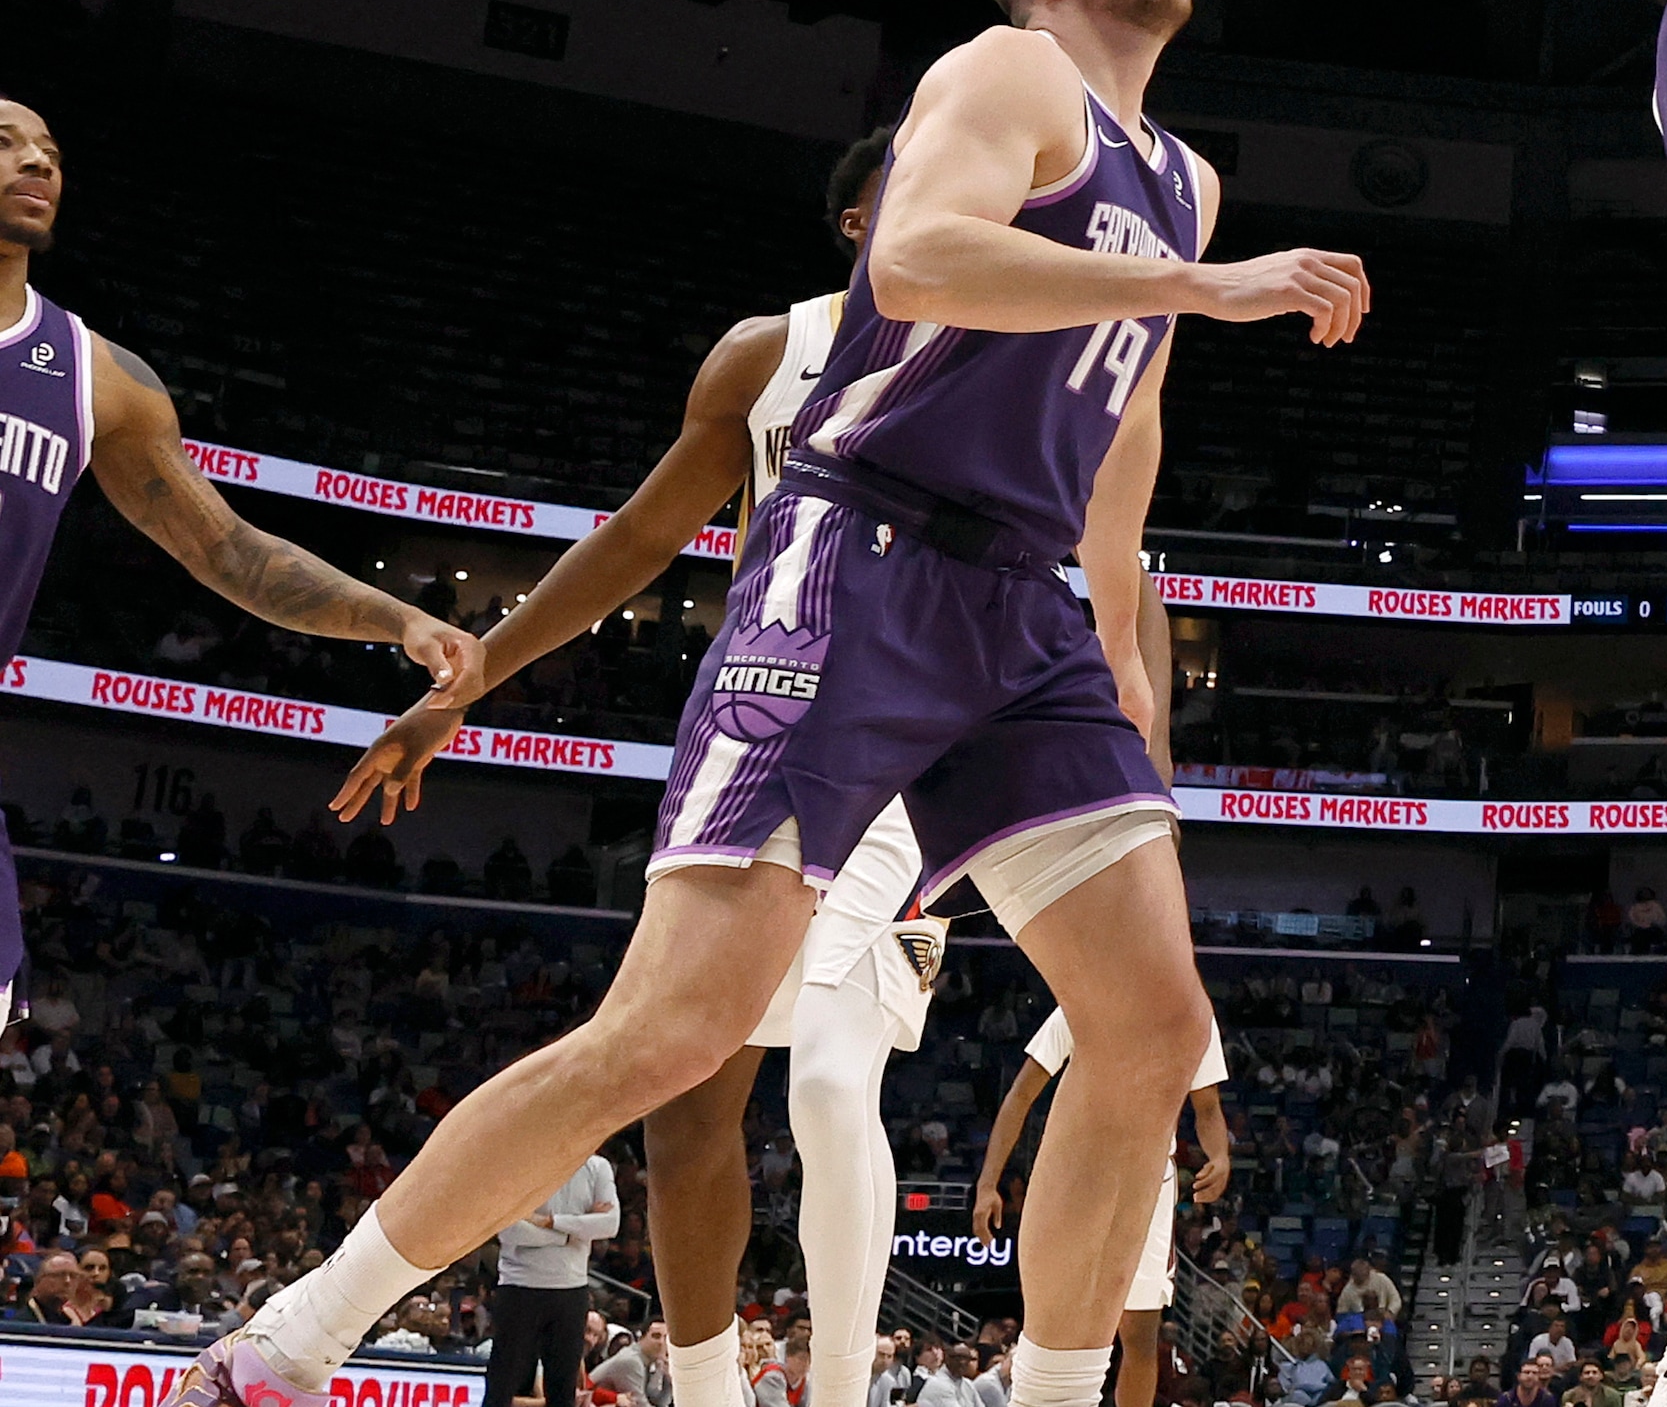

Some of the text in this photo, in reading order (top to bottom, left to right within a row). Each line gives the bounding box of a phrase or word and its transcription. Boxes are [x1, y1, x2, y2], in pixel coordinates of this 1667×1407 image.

[184, 443, 259, 482] RKETS
[316, 471, 534, 528] ROUSES MARKETS
[1213, 581, 1315, 607] MARKETS
[1369, 590, 1560, 620] ROUSES MARKETS
[1574, 601, 1622, 616] FOULS
[1639, 601, 1651, 618] 0
[724, 655, 819, 671] SACRAMENTO
[714, 666, 820, 699] KINGS
[93, 673, 325, 734] ROUSES MARKETS
[492, 733, 614, 769] MARKETS
[1222, 793, 1427, 825] ROUSES MARKETS
[1483, 805, 1569, 829] ROUSES
[892, 1230, 1012, 1265] ntergy
